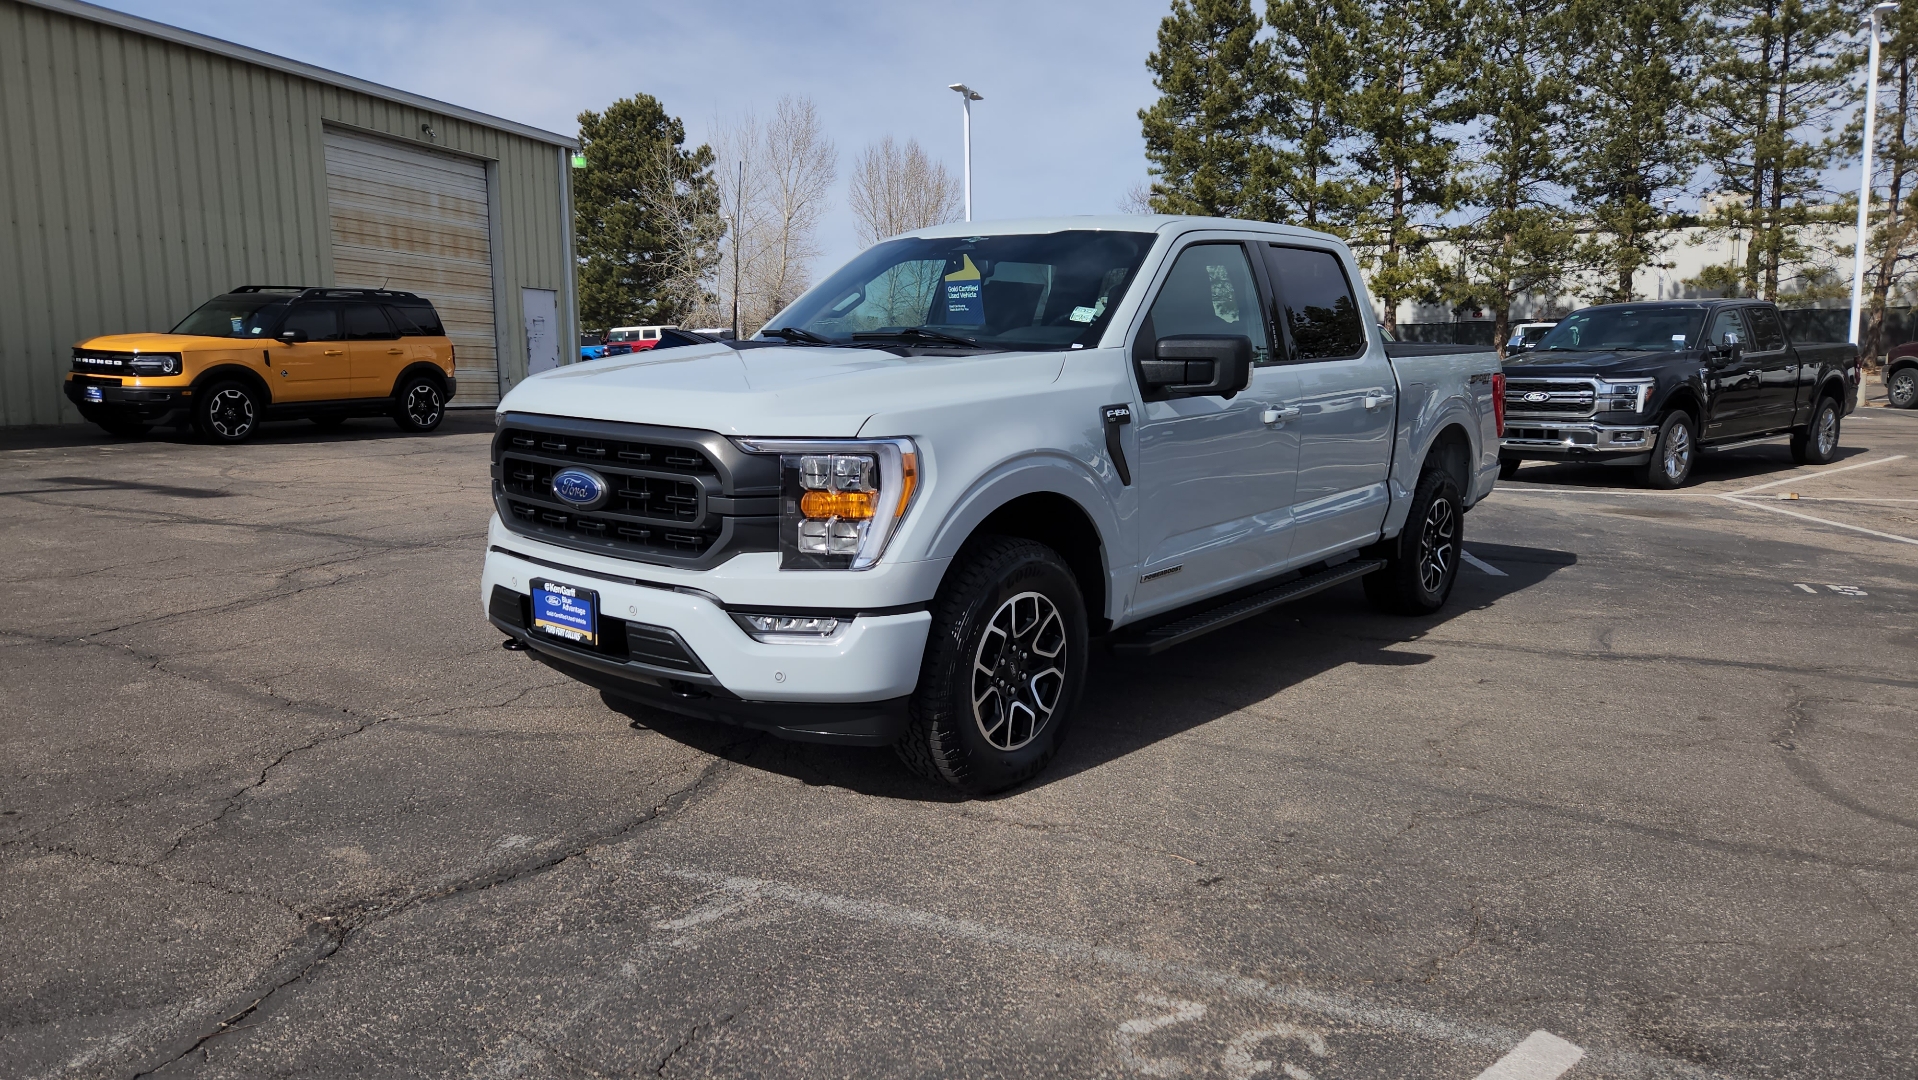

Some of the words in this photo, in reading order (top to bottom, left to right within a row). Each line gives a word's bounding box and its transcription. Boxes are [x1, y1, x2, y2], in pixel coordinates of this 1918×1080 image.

[562, 477, 588, 498] Ford
[561, 596, 572, 605] Blue
[562, 603, 586, 616] Advantage
